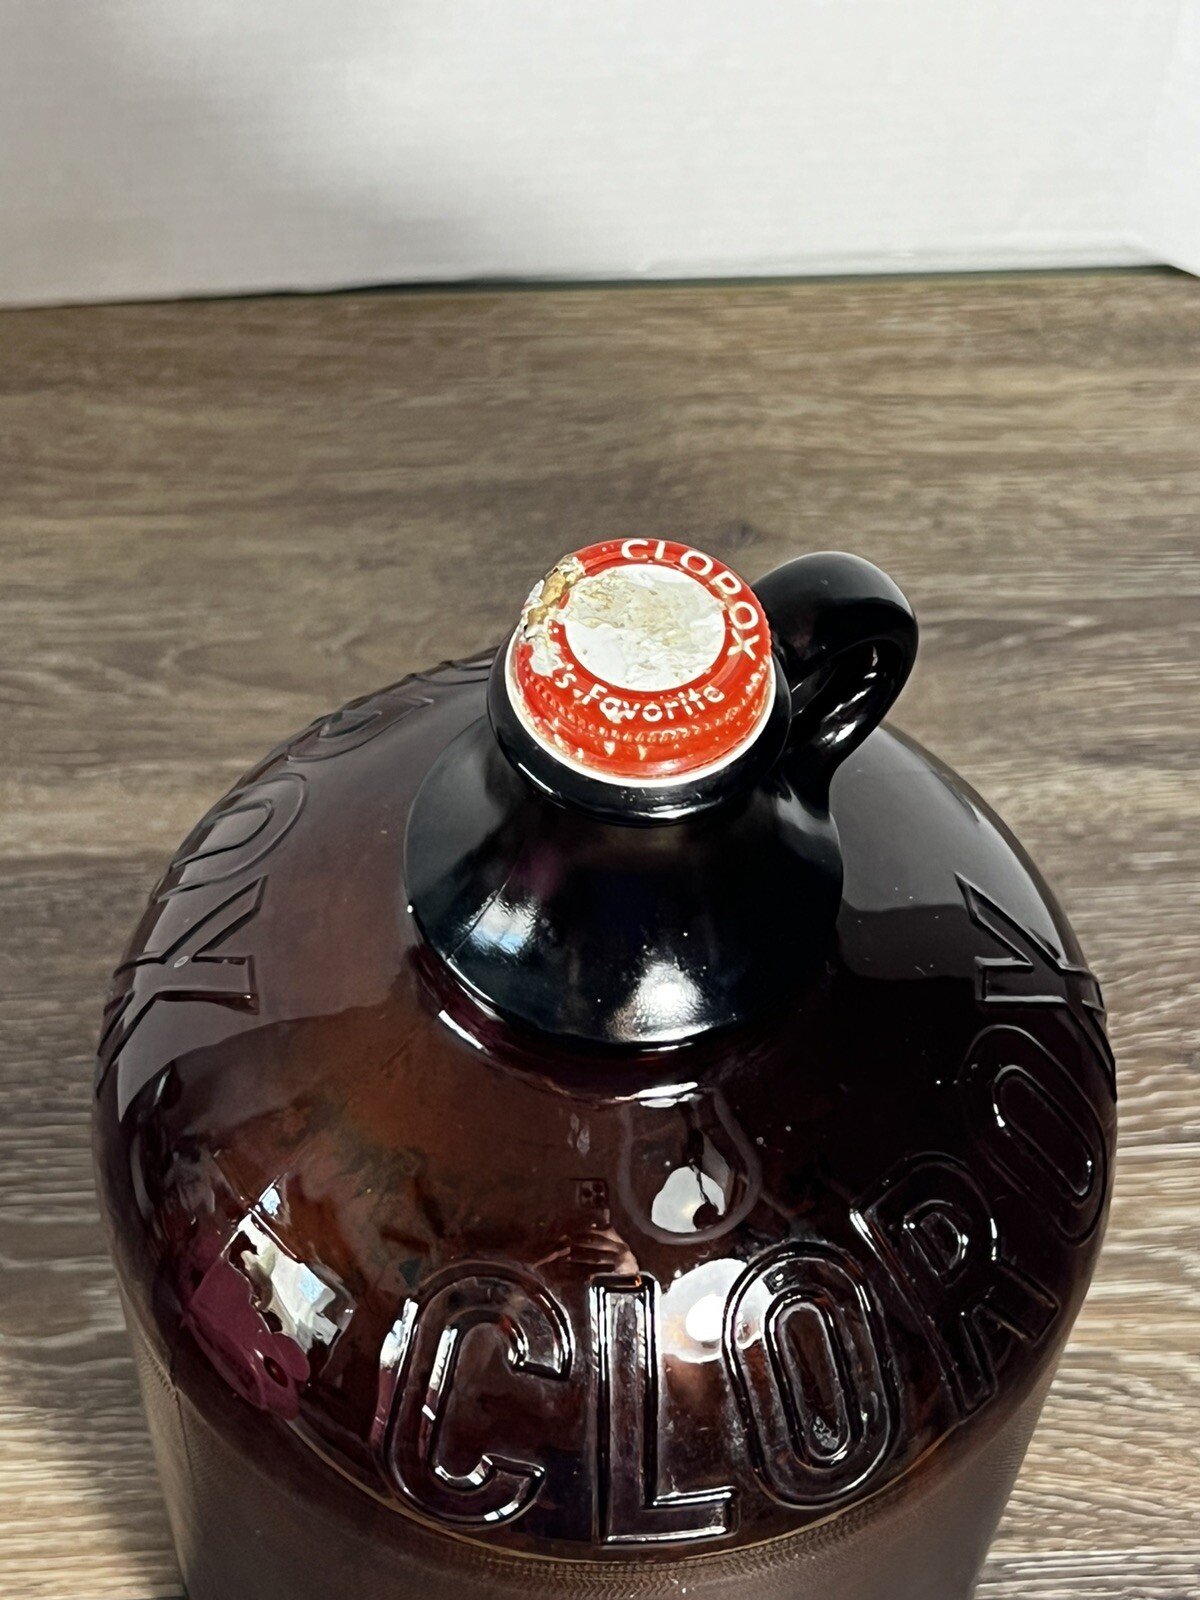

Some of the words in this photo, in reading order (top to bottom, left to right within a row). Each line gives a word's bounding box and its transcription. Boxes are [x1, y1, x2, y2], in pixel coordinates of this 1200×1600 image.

[621, 539, 760, 661] CLOROX
[581, 683, 726, 724] Favorite
[382, 872, 1117, 1544] CLOROX
